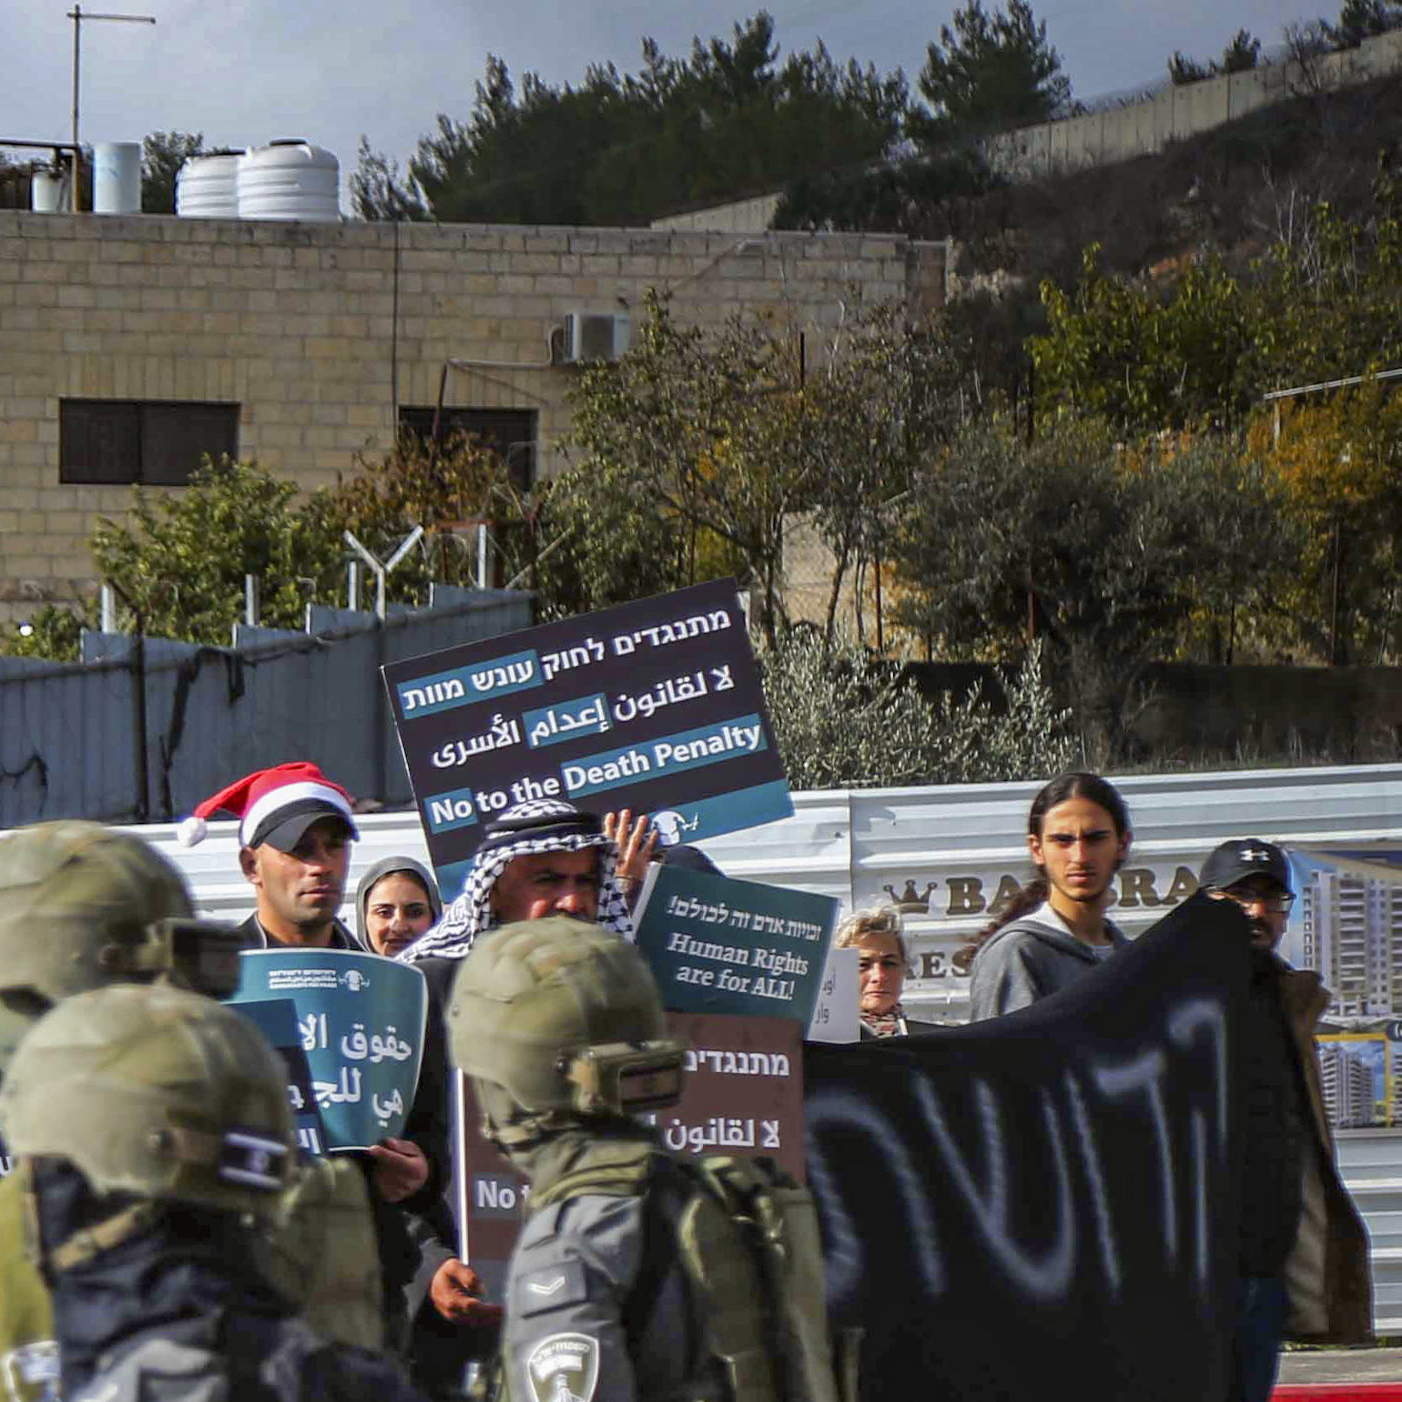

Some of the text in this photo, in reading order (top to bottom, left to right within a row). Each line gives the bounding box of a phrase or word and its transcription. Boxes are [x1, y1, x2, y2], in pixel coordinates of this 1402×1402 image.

[403, 608, 732, 710] מתנגדים לחוק עונש מוות
[431, 664, 736, 768] لا لقانون إعدام الأسرى
[429, 718, 763, 826] No to the Death Penalty
[666, 895, 729, 923] לכולם!
[729, 910, 750, 928] זה
[752, 913, 785, 935] אדם
[667, 932, 809, 977] Human Rights
[676, 966, 795, 1000] are for ALL!
[340, 1023, 412, 1063] حقوق
[373, 1088, 404, 1129] هي
[665, 1117, 781, 1153] لا لقانون
[476, 1180, 515, 1208] No
